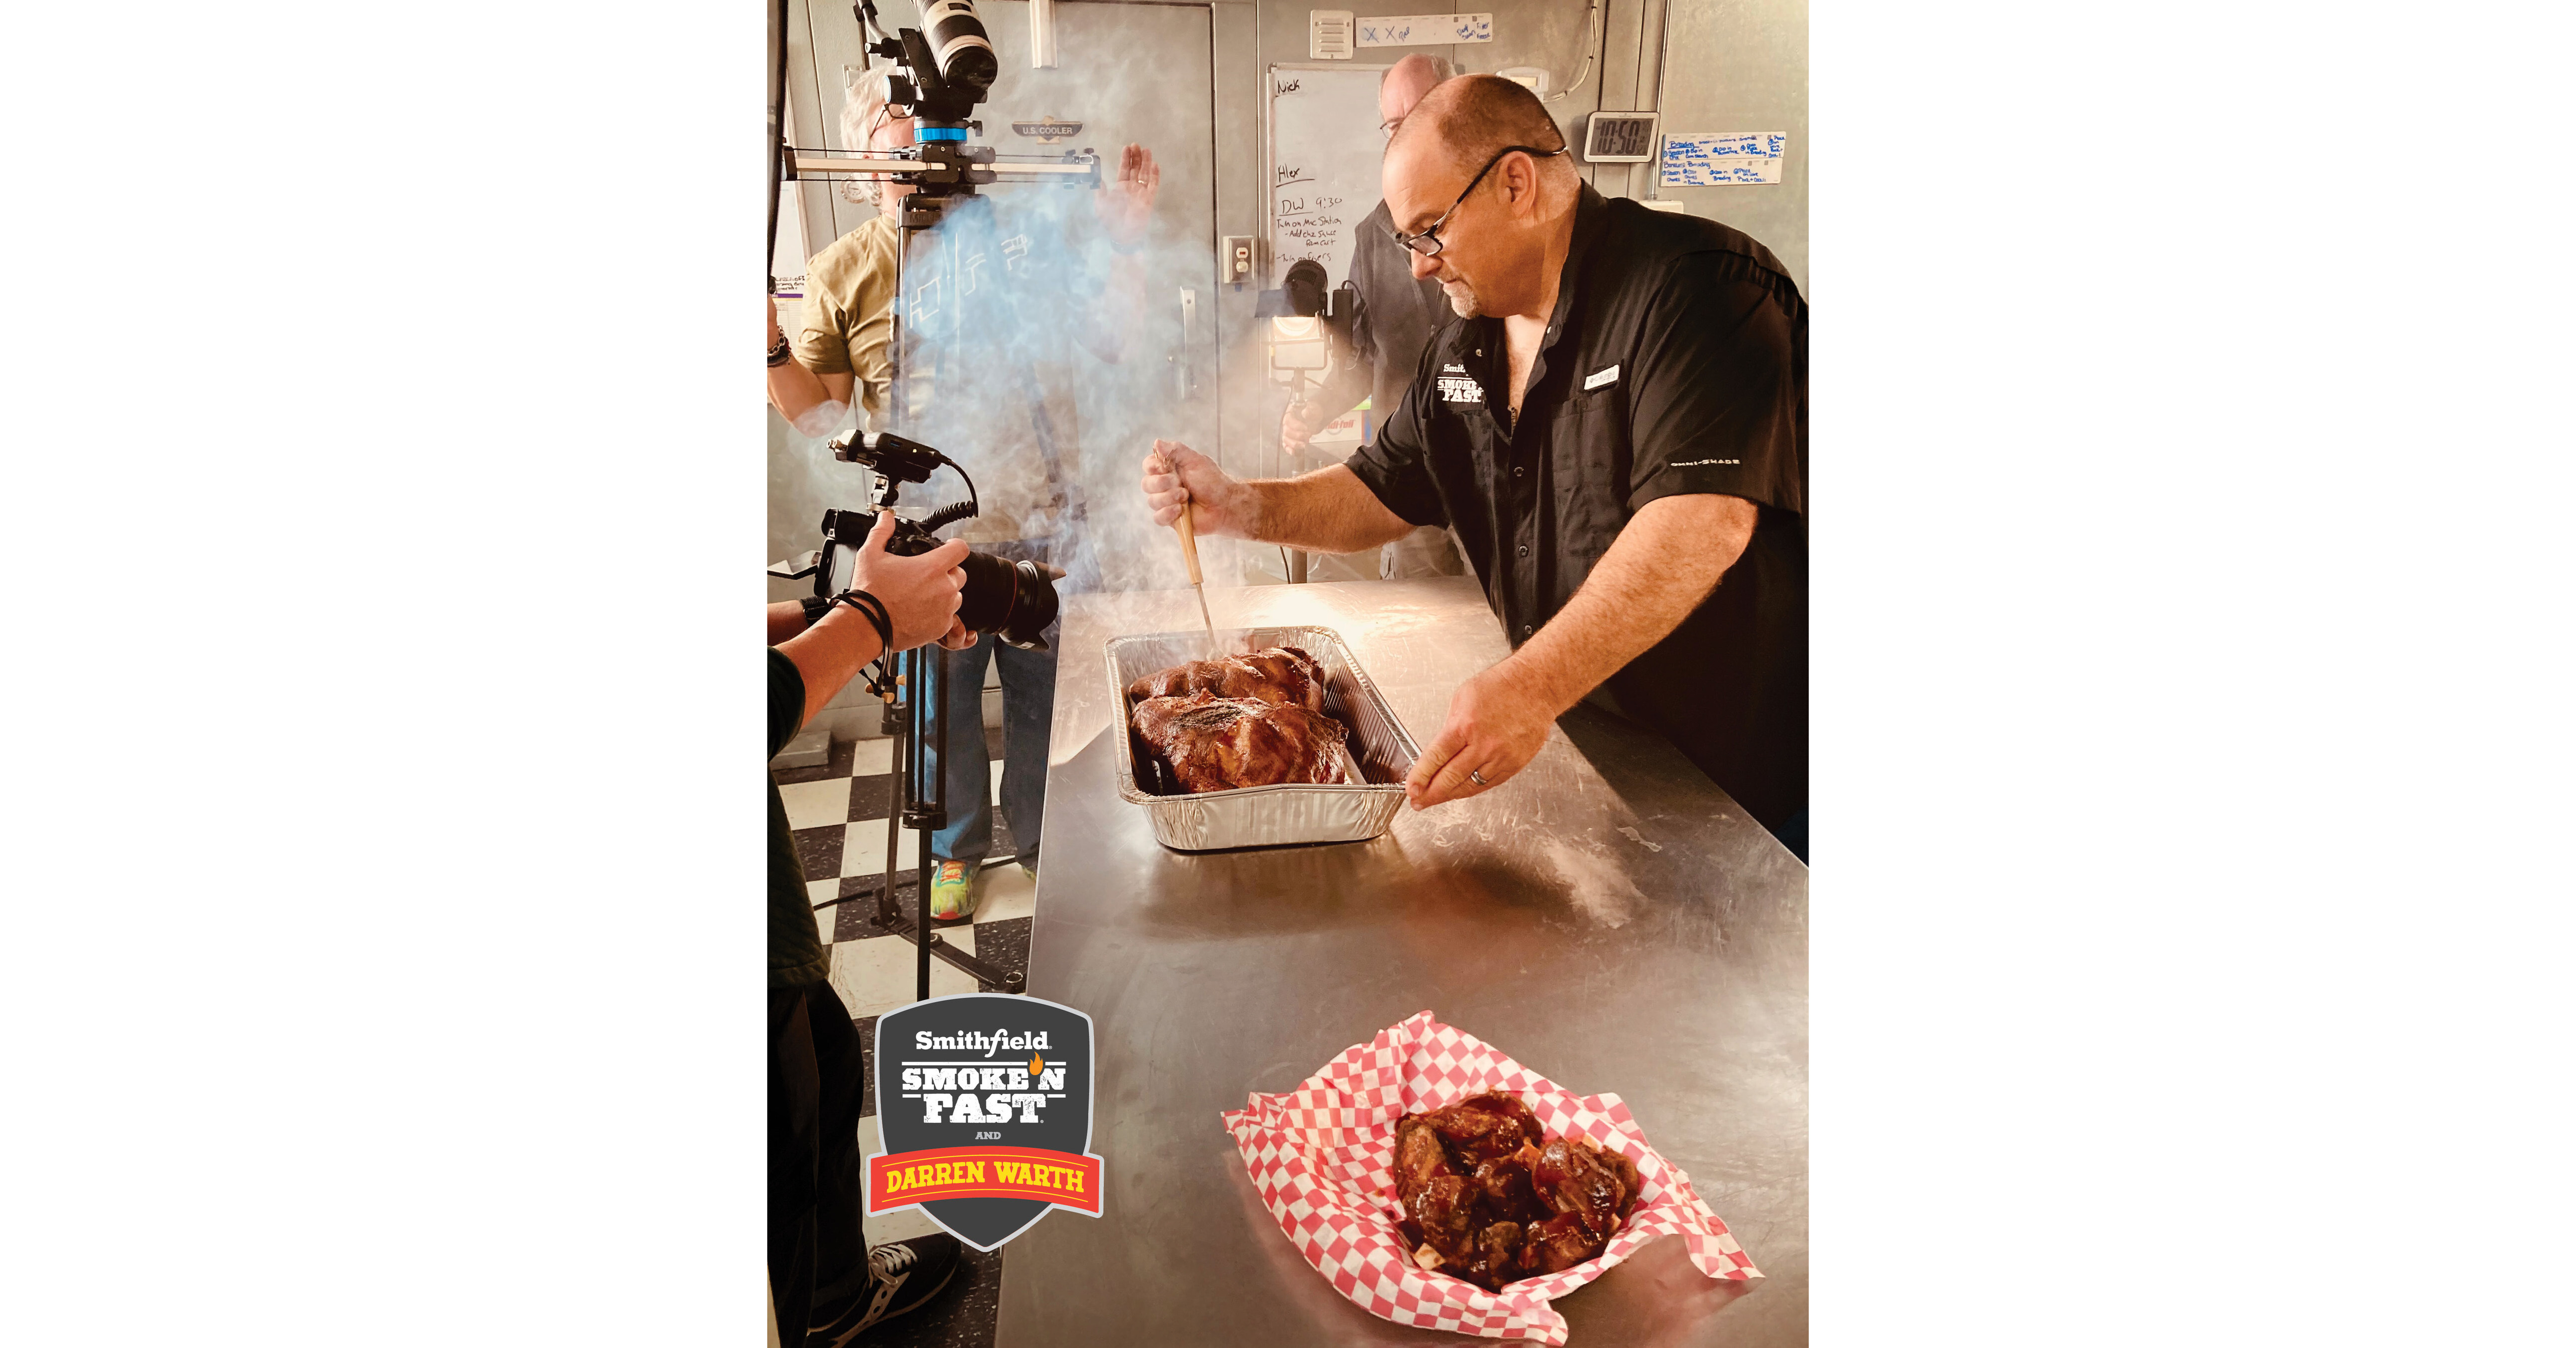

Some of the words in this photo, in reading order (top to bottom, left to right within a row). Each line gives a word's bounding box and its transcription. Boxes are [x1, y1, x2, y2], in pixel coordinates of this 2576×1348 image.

[1277, 79, 1300, 93] Nick
[1597, 120, 1640, 154] 10:50
[1278, 163, 1300, 182] Alex
[1282, 198, 1304, 214] DW
[1316, 197, 1342, 210] 9:30
[1318, 216, 1342, 226] Station
